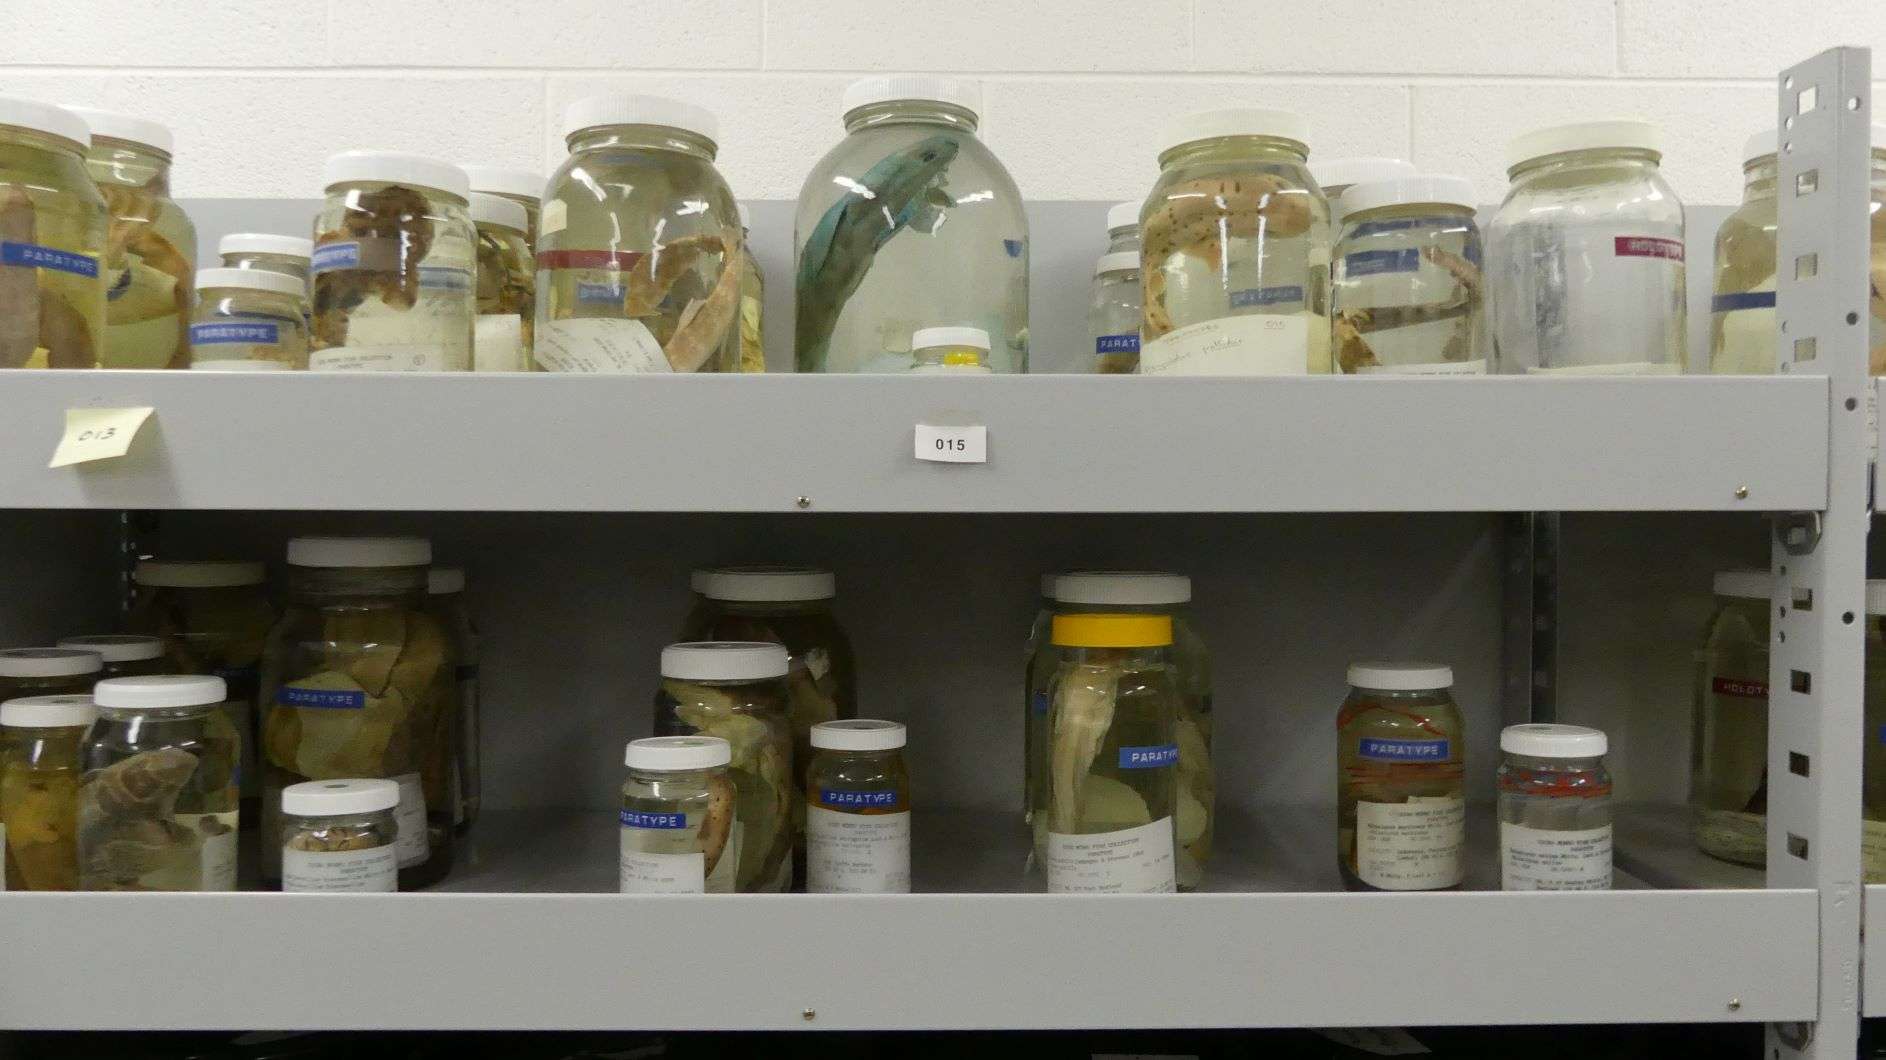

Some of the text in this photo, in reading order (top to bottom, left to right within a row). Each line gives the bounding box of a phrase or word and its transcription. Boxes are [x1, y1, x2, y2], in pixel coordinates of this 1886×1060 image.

[23, 249, 94, 273] PARATYPE
[78, 427, 117, 442] 013
[935, 438, 965, 451] 015
[287, 691, 354, 705] PARATYPE
[1369, 743, 1438, 756] PARATYPE
[827, 792, 895, 804] PARATYPE
[620, 810, 677, 827] PARATYPE
